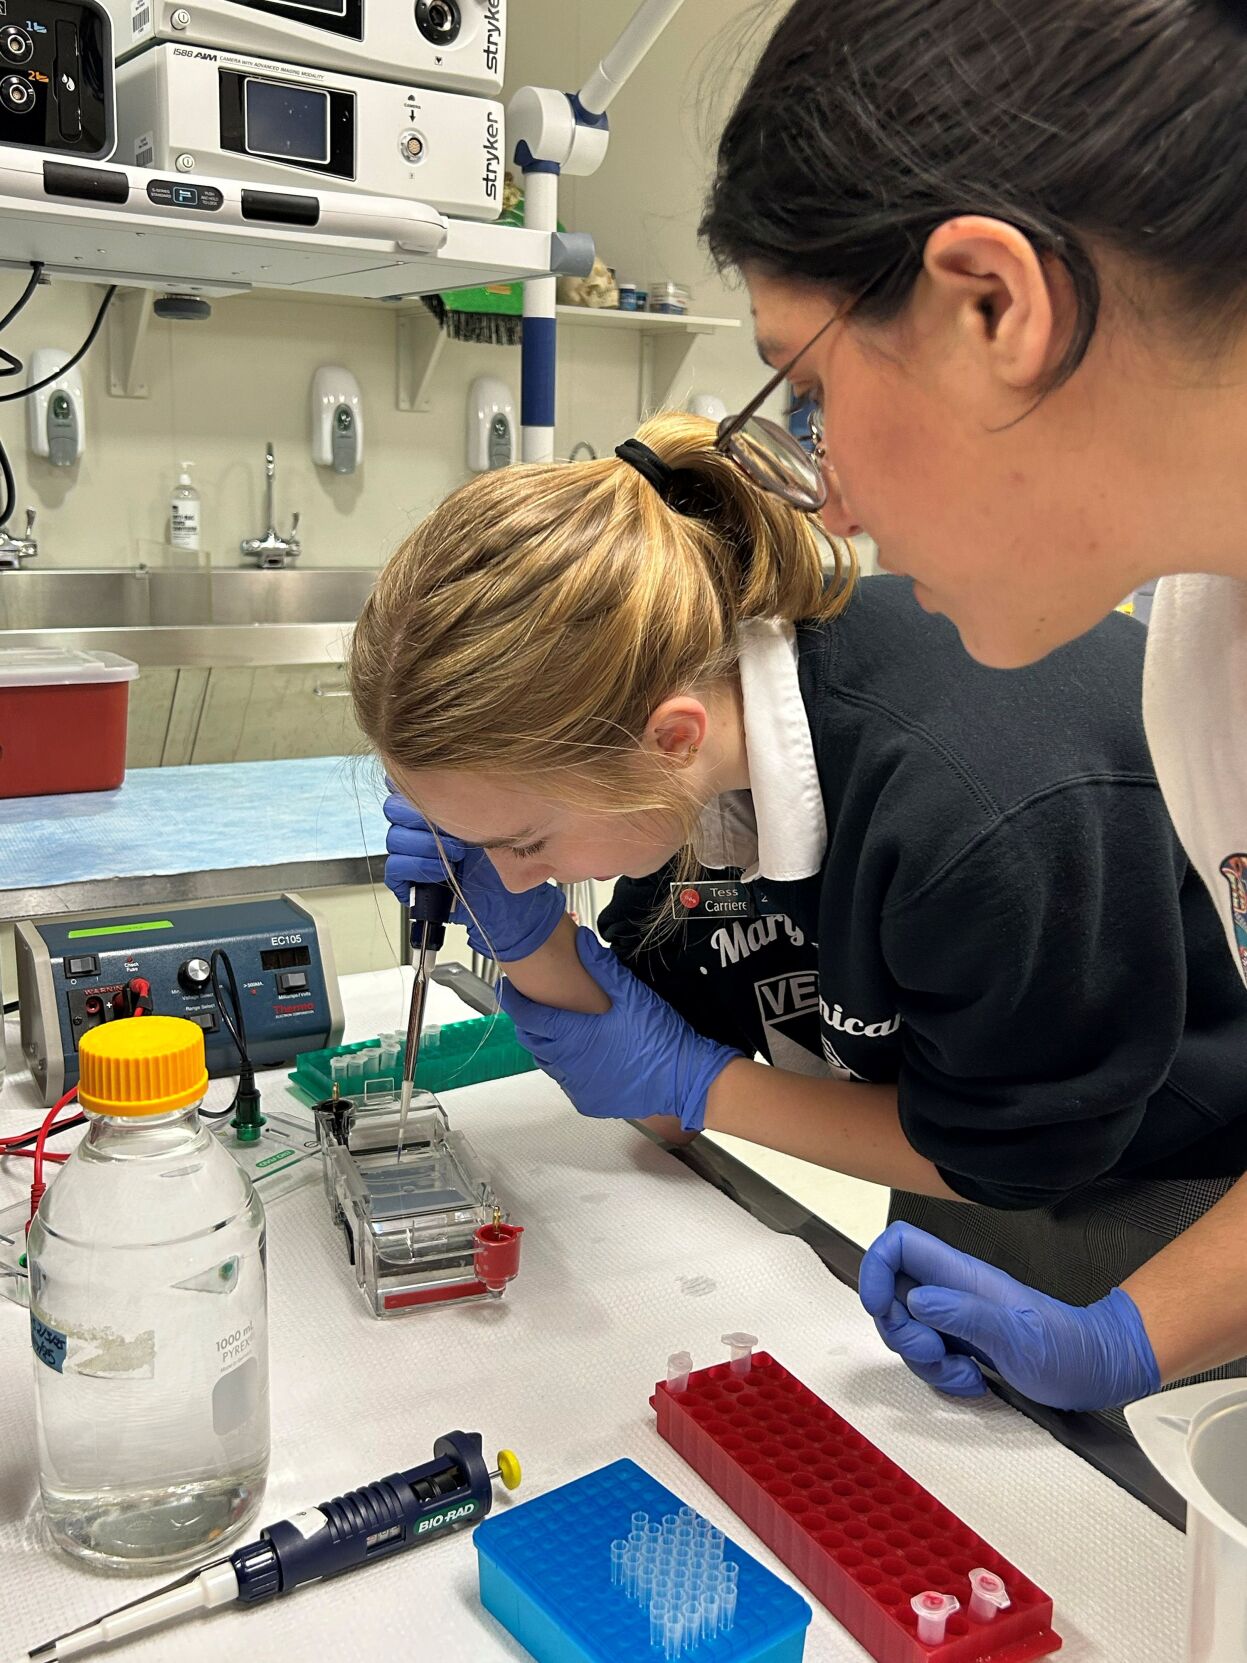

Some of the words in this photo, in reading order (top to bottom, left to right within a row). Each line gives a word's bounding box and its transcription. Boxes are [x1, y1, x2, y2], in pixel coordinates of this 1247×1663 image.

[483, 0, 501, 74] stryke
[194, 52, 218, 62] AIM
[219, 55, 241, 64] CAMERA
[254, 62, 280, 71] ADVANCED
[280, 67, 301, 76] IMAGING
[301, 71, 325, 80] MODALITY
[482, 112, 501, 201] stryker
[709, 887, 739, 897] Tess
[704, 900, 748, 912] Carriere
[271, 934, 302, 946] EC105
[711, 913, 805, 968] Mary
[84, 985, 123, 995] WARNIN
[761, 975, 819, 1015] VE
[273, 1002, 314, 1013] Thermo
[216, 1330, 241, 1352] 1000
[418, 1503, 475, 1533] BIO-RAD
